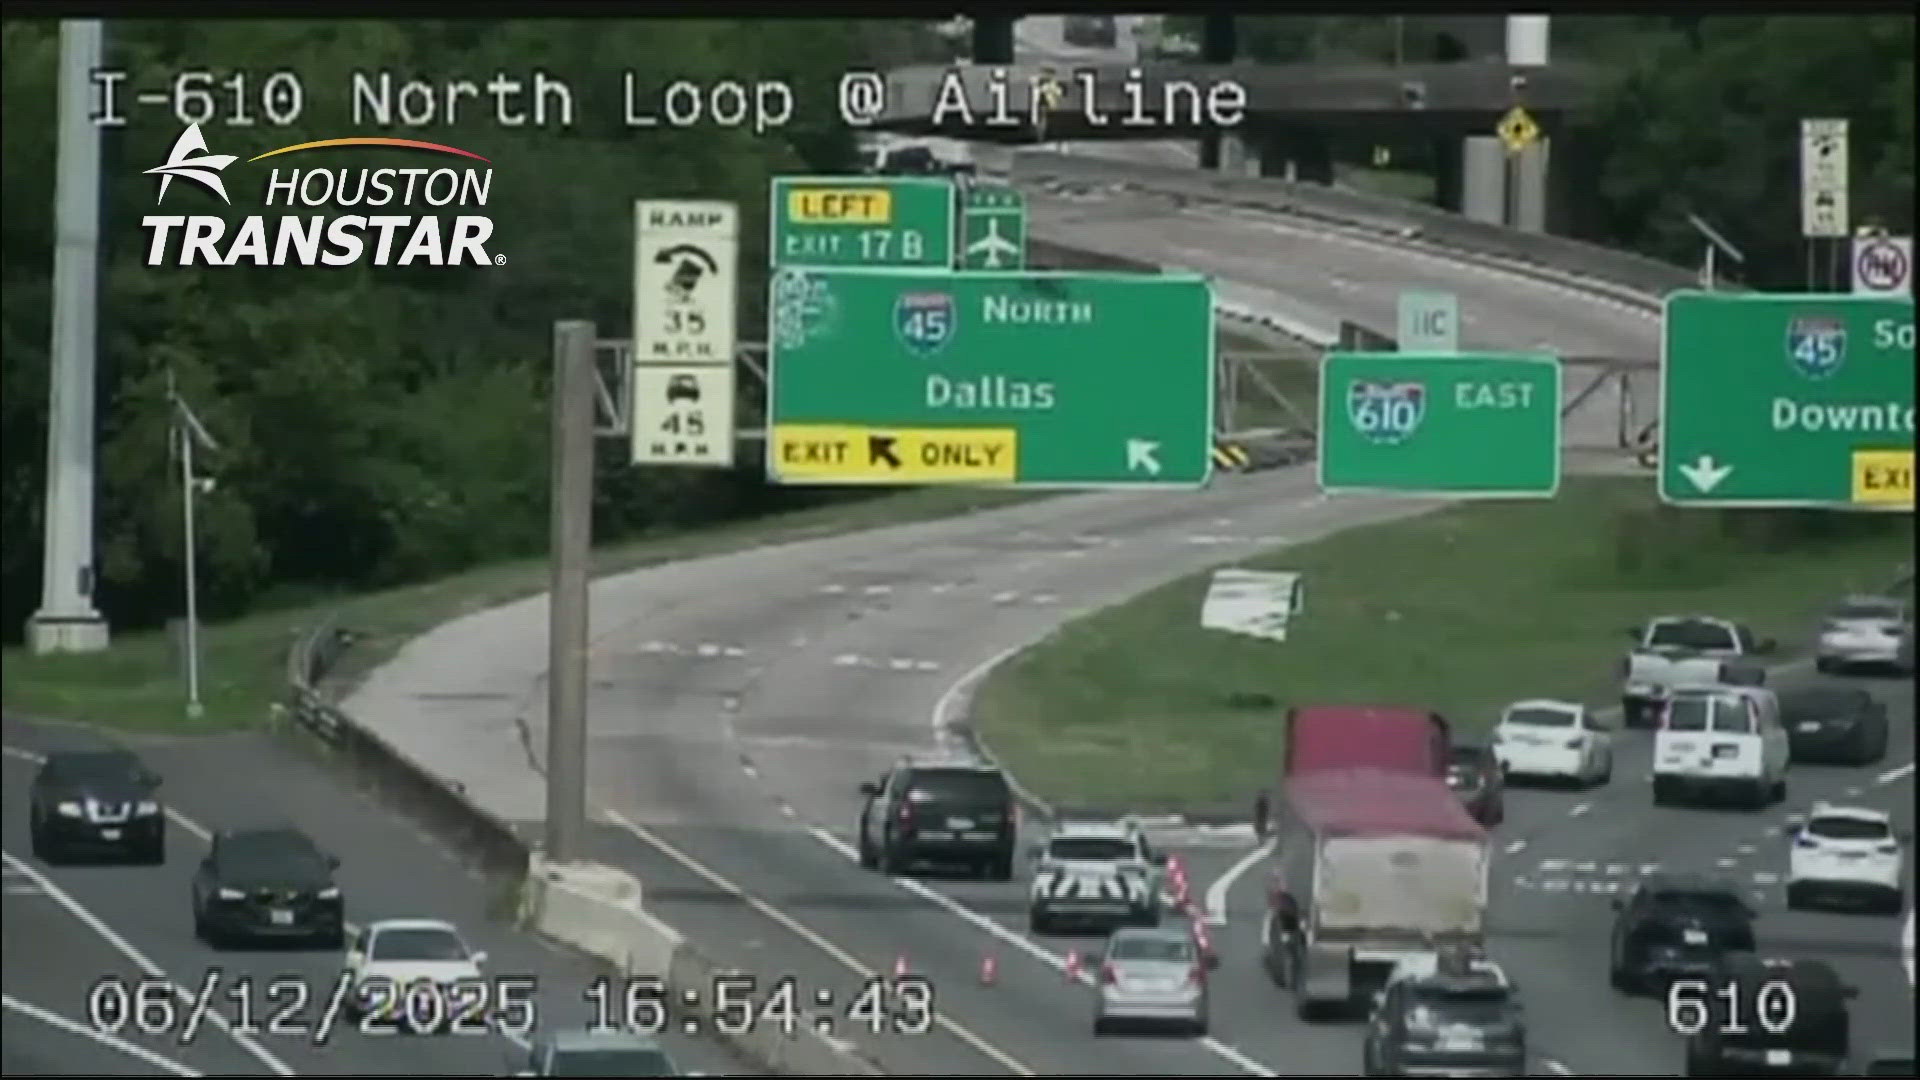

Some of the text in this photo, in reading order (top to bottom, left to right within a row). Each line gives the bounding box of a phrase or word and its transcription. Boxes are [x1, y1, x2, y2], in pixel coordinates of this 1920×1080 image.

[802, 194, 874, 218] LEFT
[785, 235, 841, 256] EXIT
[664, 310, 706, 335] 35
[904, 310, 948, 342] 45
[1793, 334, 1838, 366] 45
[924, 373, 1056, 411] Dallas
[1455, 383, 1533, 409] EAST
[660, 412, 705, 435] 45
[1354, 399, 1416, 433] 610
[782, 442, 1004, 468] EXIT ONLY
